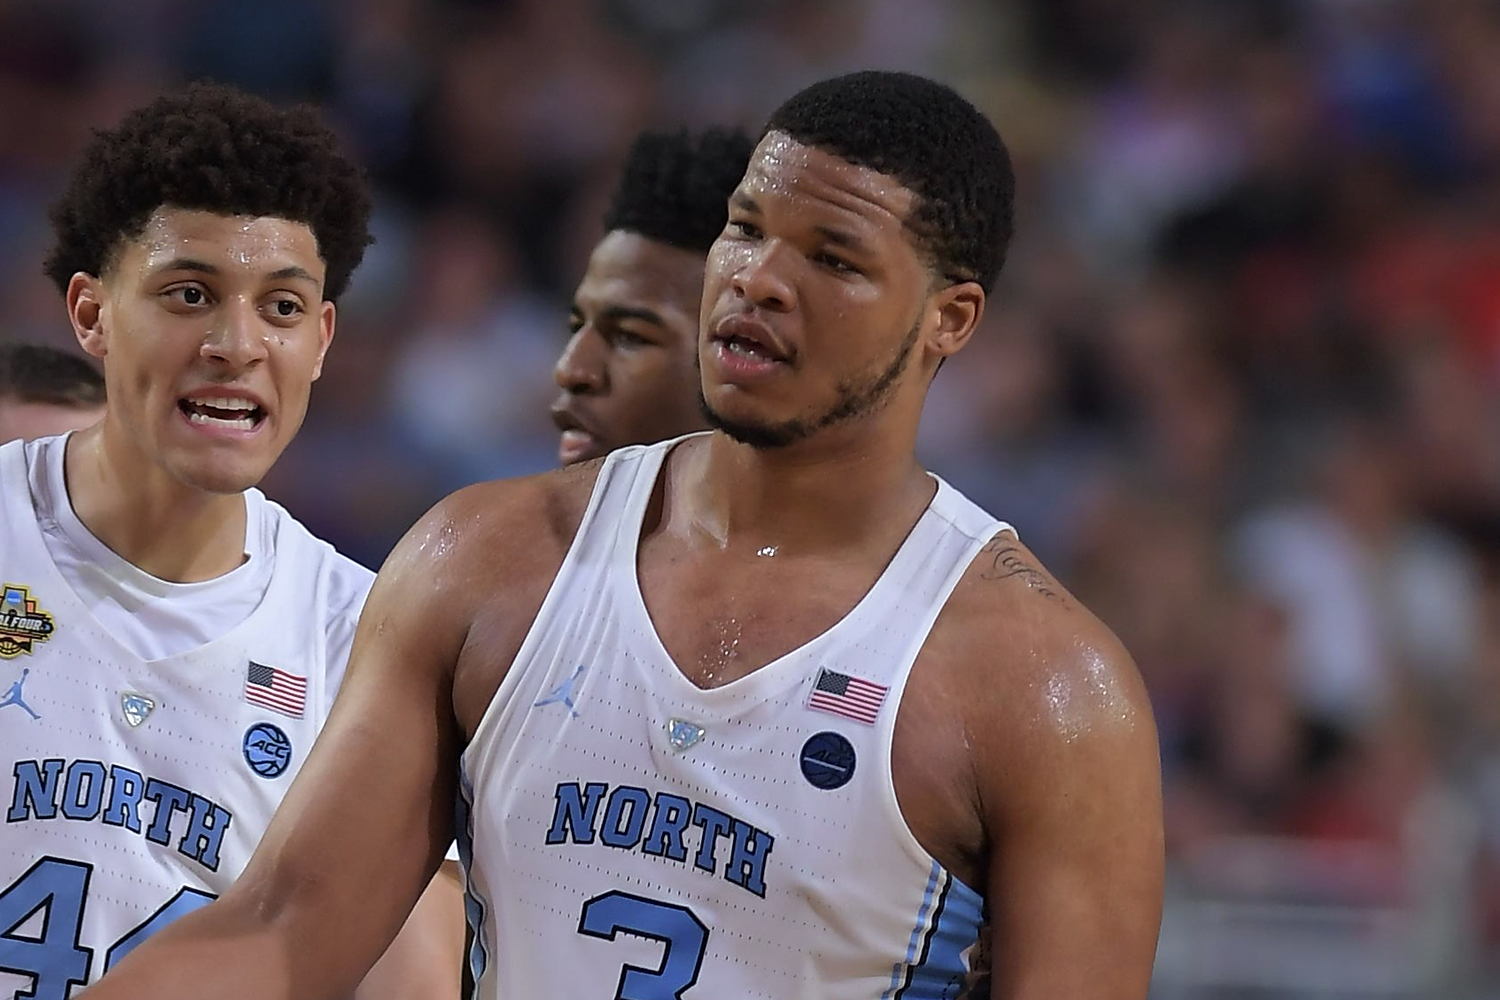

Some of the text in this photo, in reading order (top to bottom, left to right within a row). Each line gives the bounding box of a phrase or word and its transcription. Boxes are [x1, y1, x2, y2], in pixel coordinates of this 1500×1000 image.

[10, 616, 43, 632] FOUR
[250, 739, 291, 759] ACC
[6, 758, 232, 873] NORTH
[545, 782, 775, 899] NORTH
